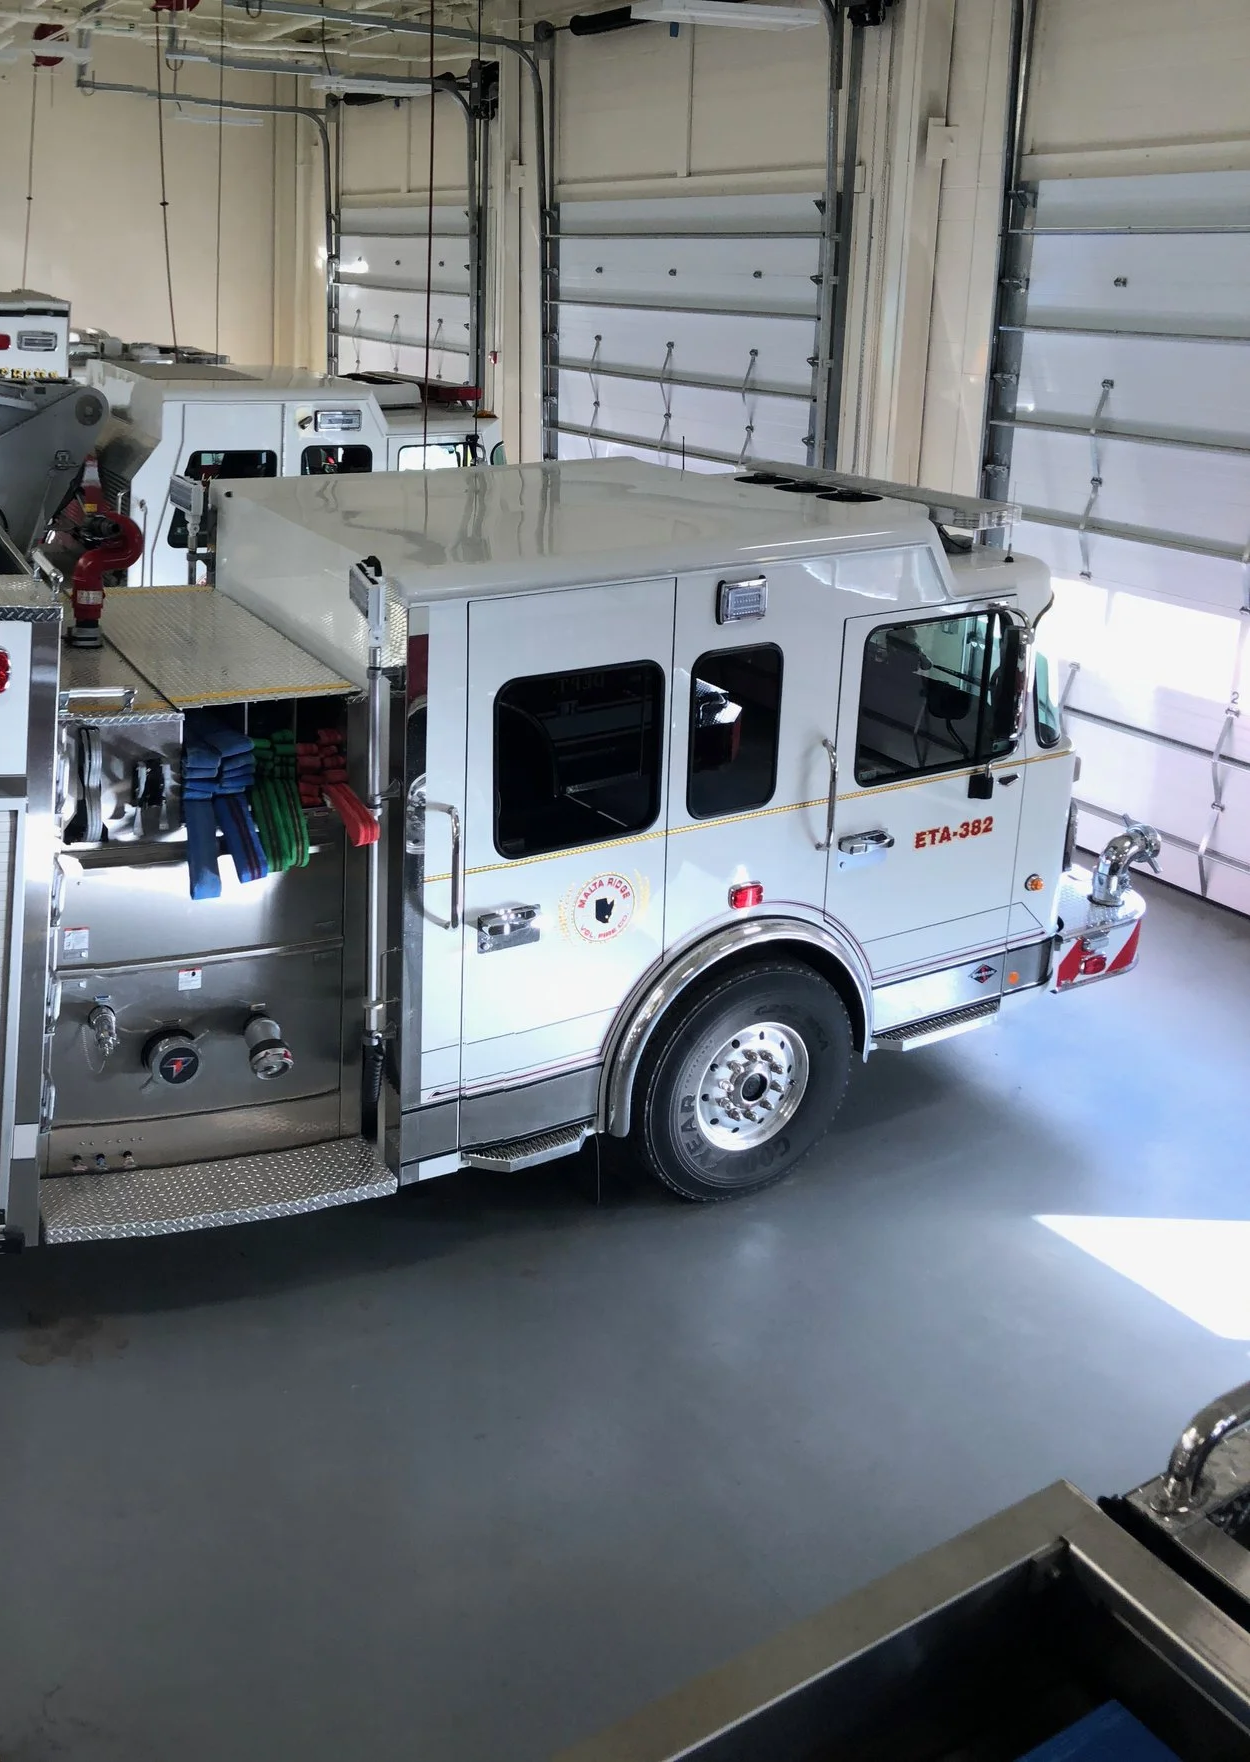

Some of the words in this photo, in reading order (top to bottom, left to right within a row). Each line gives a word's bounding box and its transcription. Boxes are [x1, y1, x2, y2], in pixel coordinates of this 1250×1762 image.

[914, 815, 994, 849] ETA-382
[578, 879, 605, 909] MALTA
[607, 877, 631, 900] RIDGE
